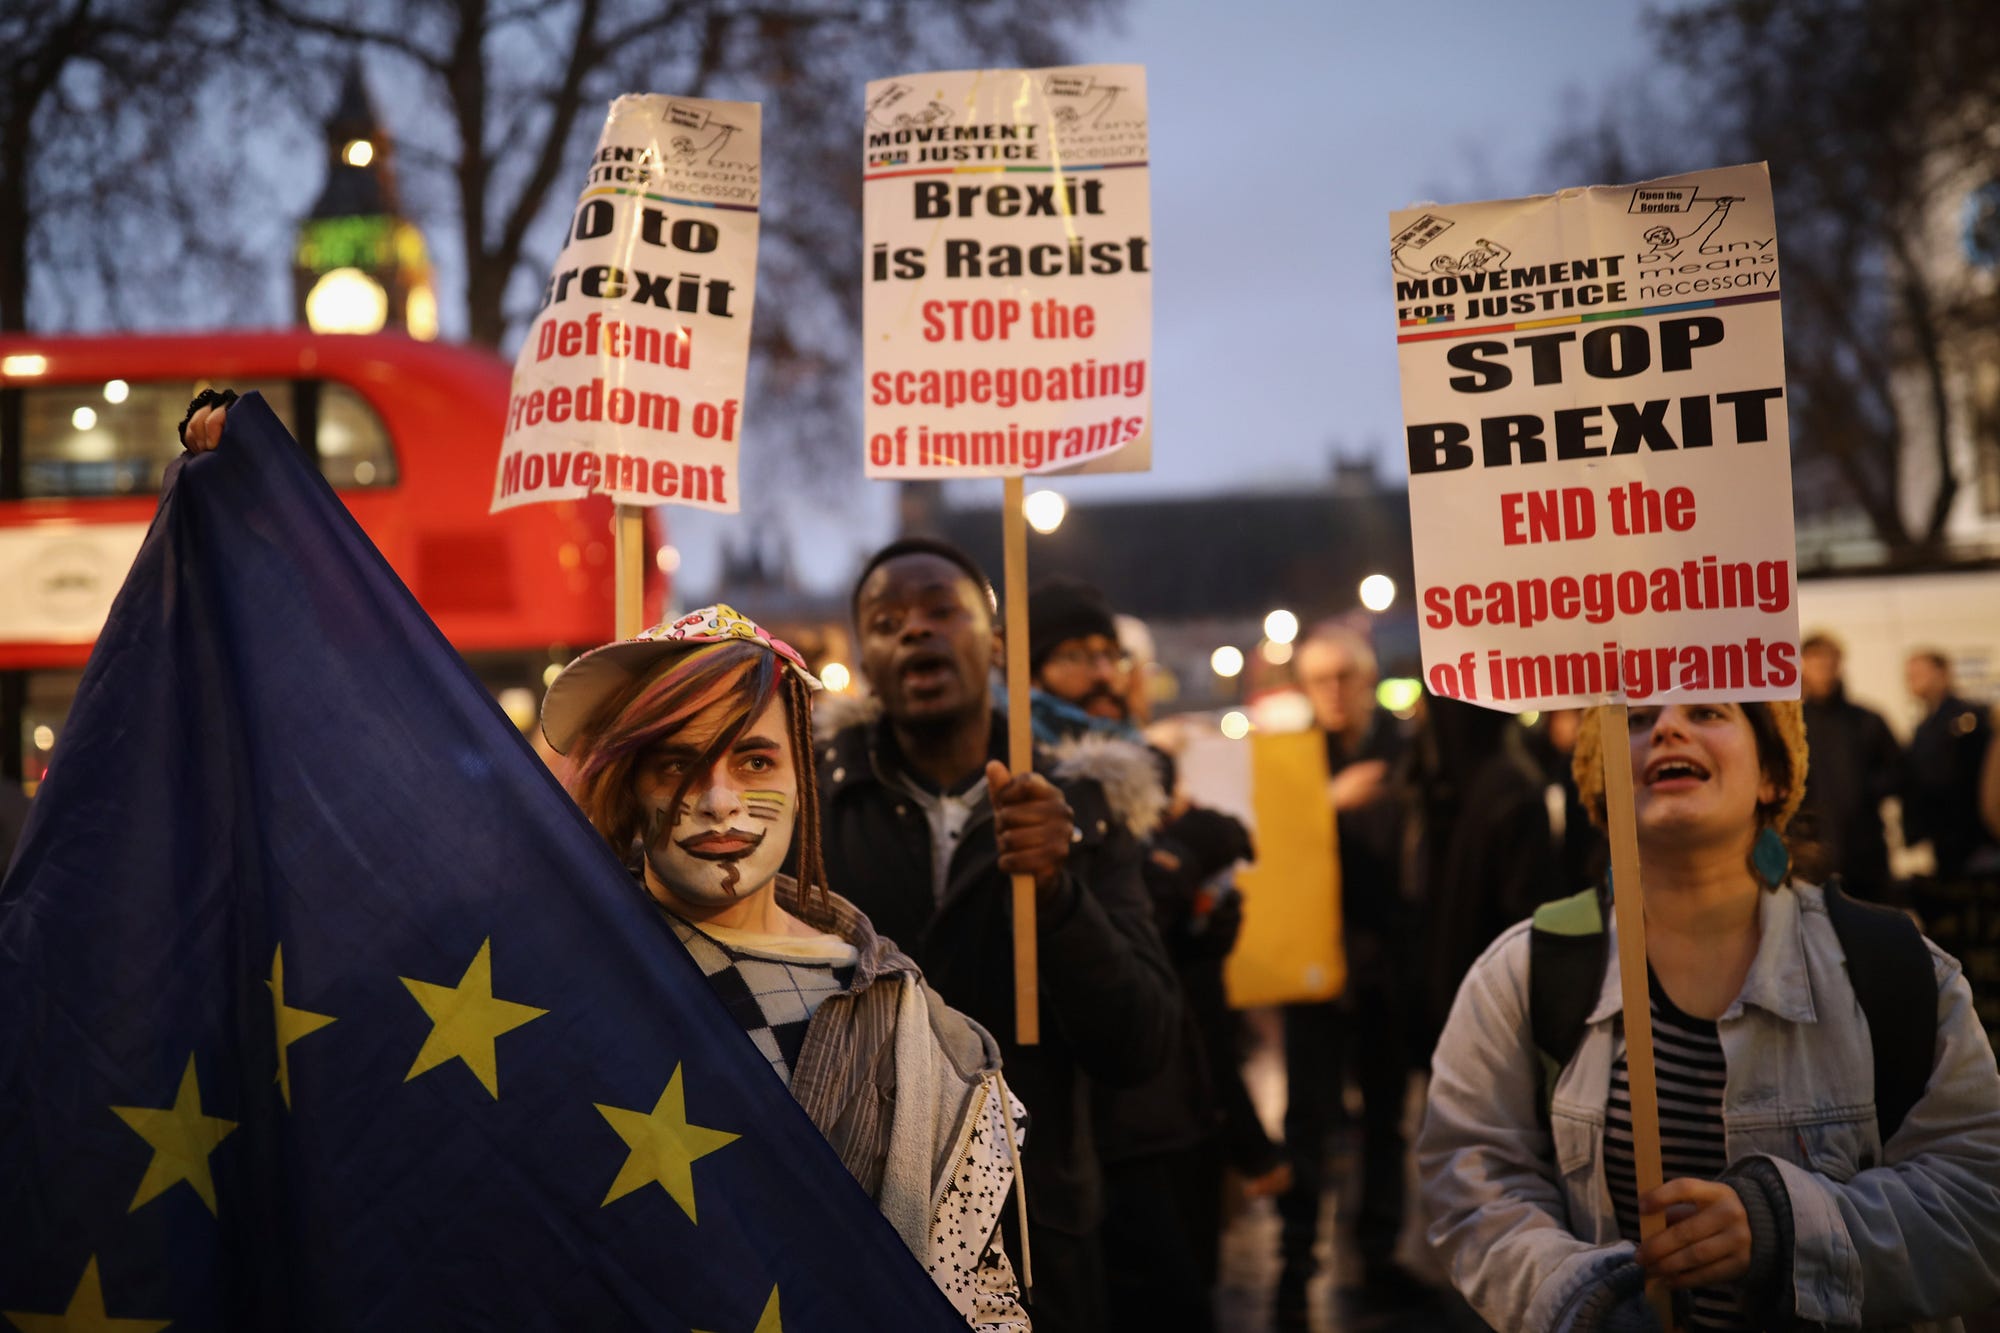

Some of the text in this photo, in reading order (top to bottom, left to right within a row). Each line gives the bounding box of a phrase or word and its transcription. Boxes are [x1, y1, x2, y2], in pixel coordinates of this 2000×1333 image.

[868, 124, 1039, 148] MOVEMENT
[917, 143, 1039, 163] JUSTICE
[914, 176, 1106, 220] Brexit
[1639, 191, 1683, 201] Open the
[1640, 203, 1680, 213] Borders
[562, 199, 719, 255] O to
[873, 236, 1150, 282] is Racist
[1636, 238, 1775, 265] by any
[1640, 253, 1775, 280] means
[543, 264, 736, 319] rexit
[1396, 254, 1625, 302] MOVEMENT
[1398, 281, 1628, 320] FOR JUSTICE
[1640, 269, 1777, 300] necessary
[536, 312, 692, 371] Defend
[921, 298, 1095, 343] STOP the
[1446, 315, 1725, 394] STOP
[871, 358, 1146, 409] scapegoating
[692, 398, 739, 443] of
[870, 415, 1144, 470] of immigrants
[1406, 386, 1784, 475] BREXIT
[500, 450, 728, 504] Movement
[1500, 481, 1697, 546] END the
[1424, 555, 1790, 629] scapegoating
[1429, 636, 1798, 700] of immigrants
